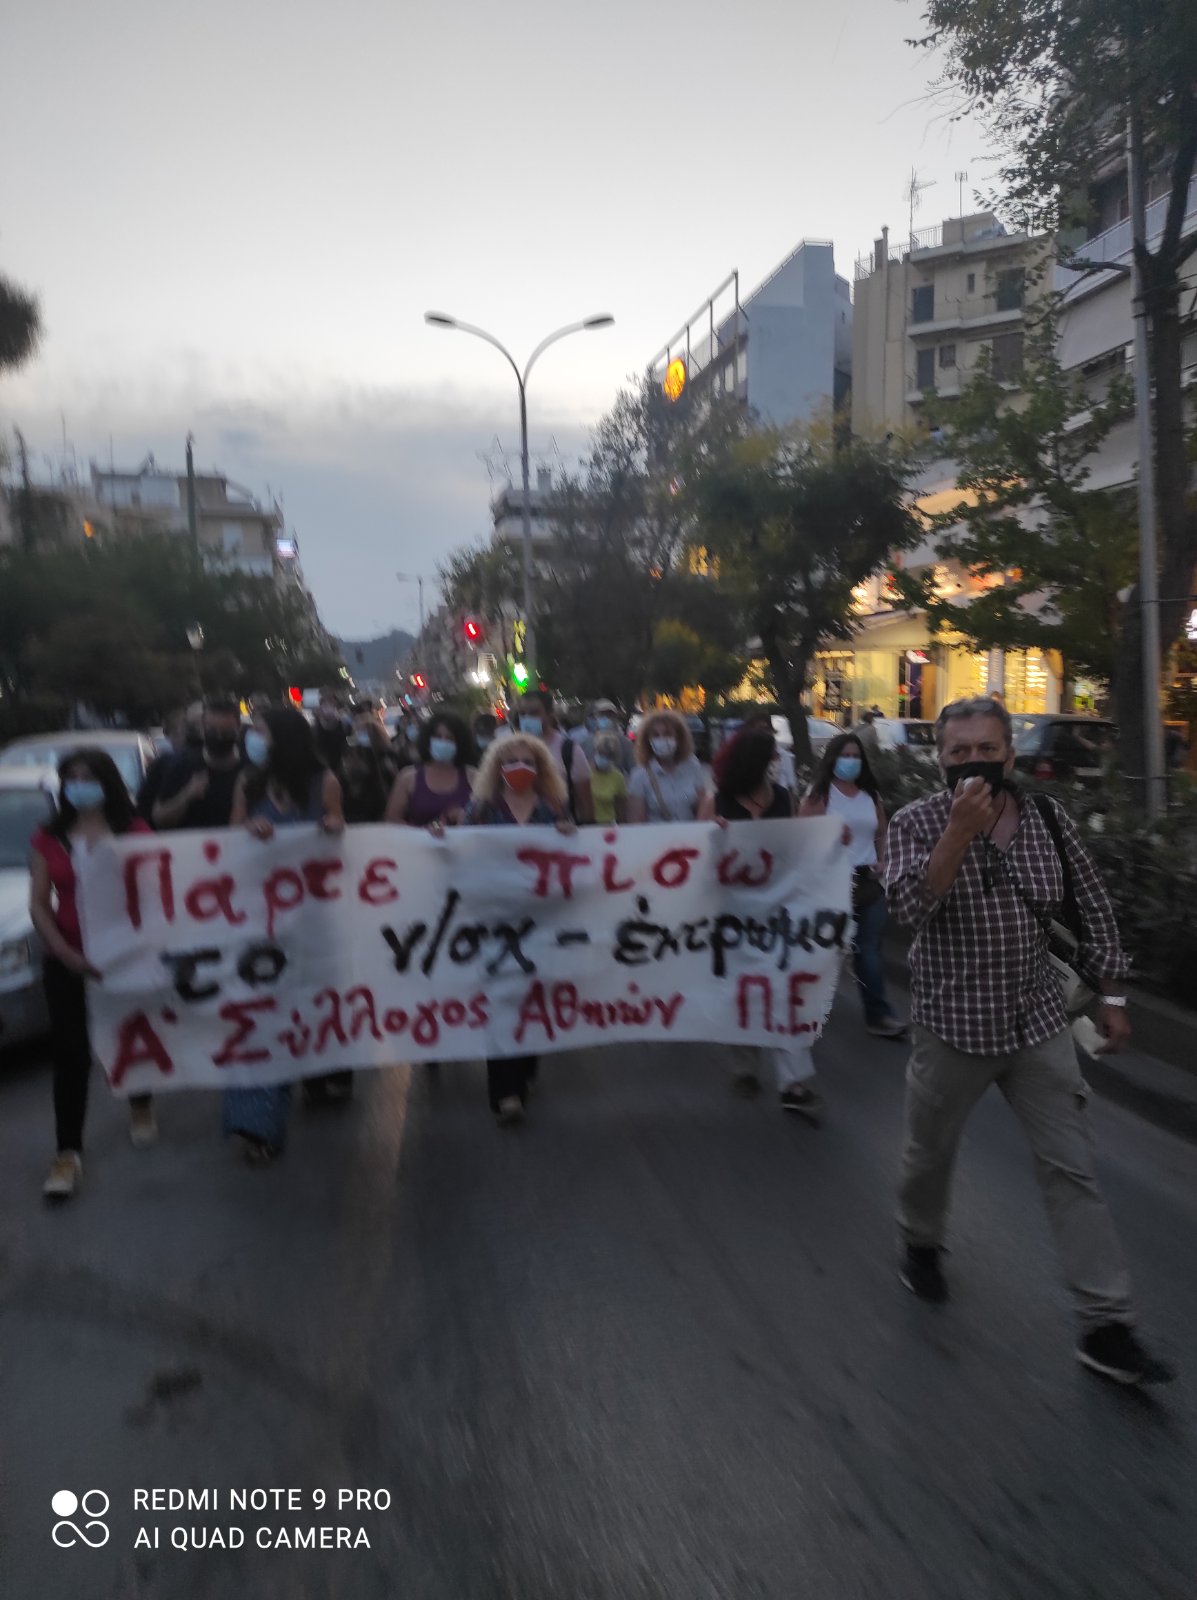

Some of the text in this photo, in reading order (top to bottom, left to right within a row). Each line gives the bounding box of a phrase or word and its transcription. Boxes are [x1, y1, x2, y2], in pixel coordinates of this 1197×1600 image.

[121, 830, 774, 939] Πάρτε πίσω
[159, 942, 288, 1000] το
[213, 985, 490, 1067] Σύλλογος
[513, 979, 686, 1044] Αθηνών
